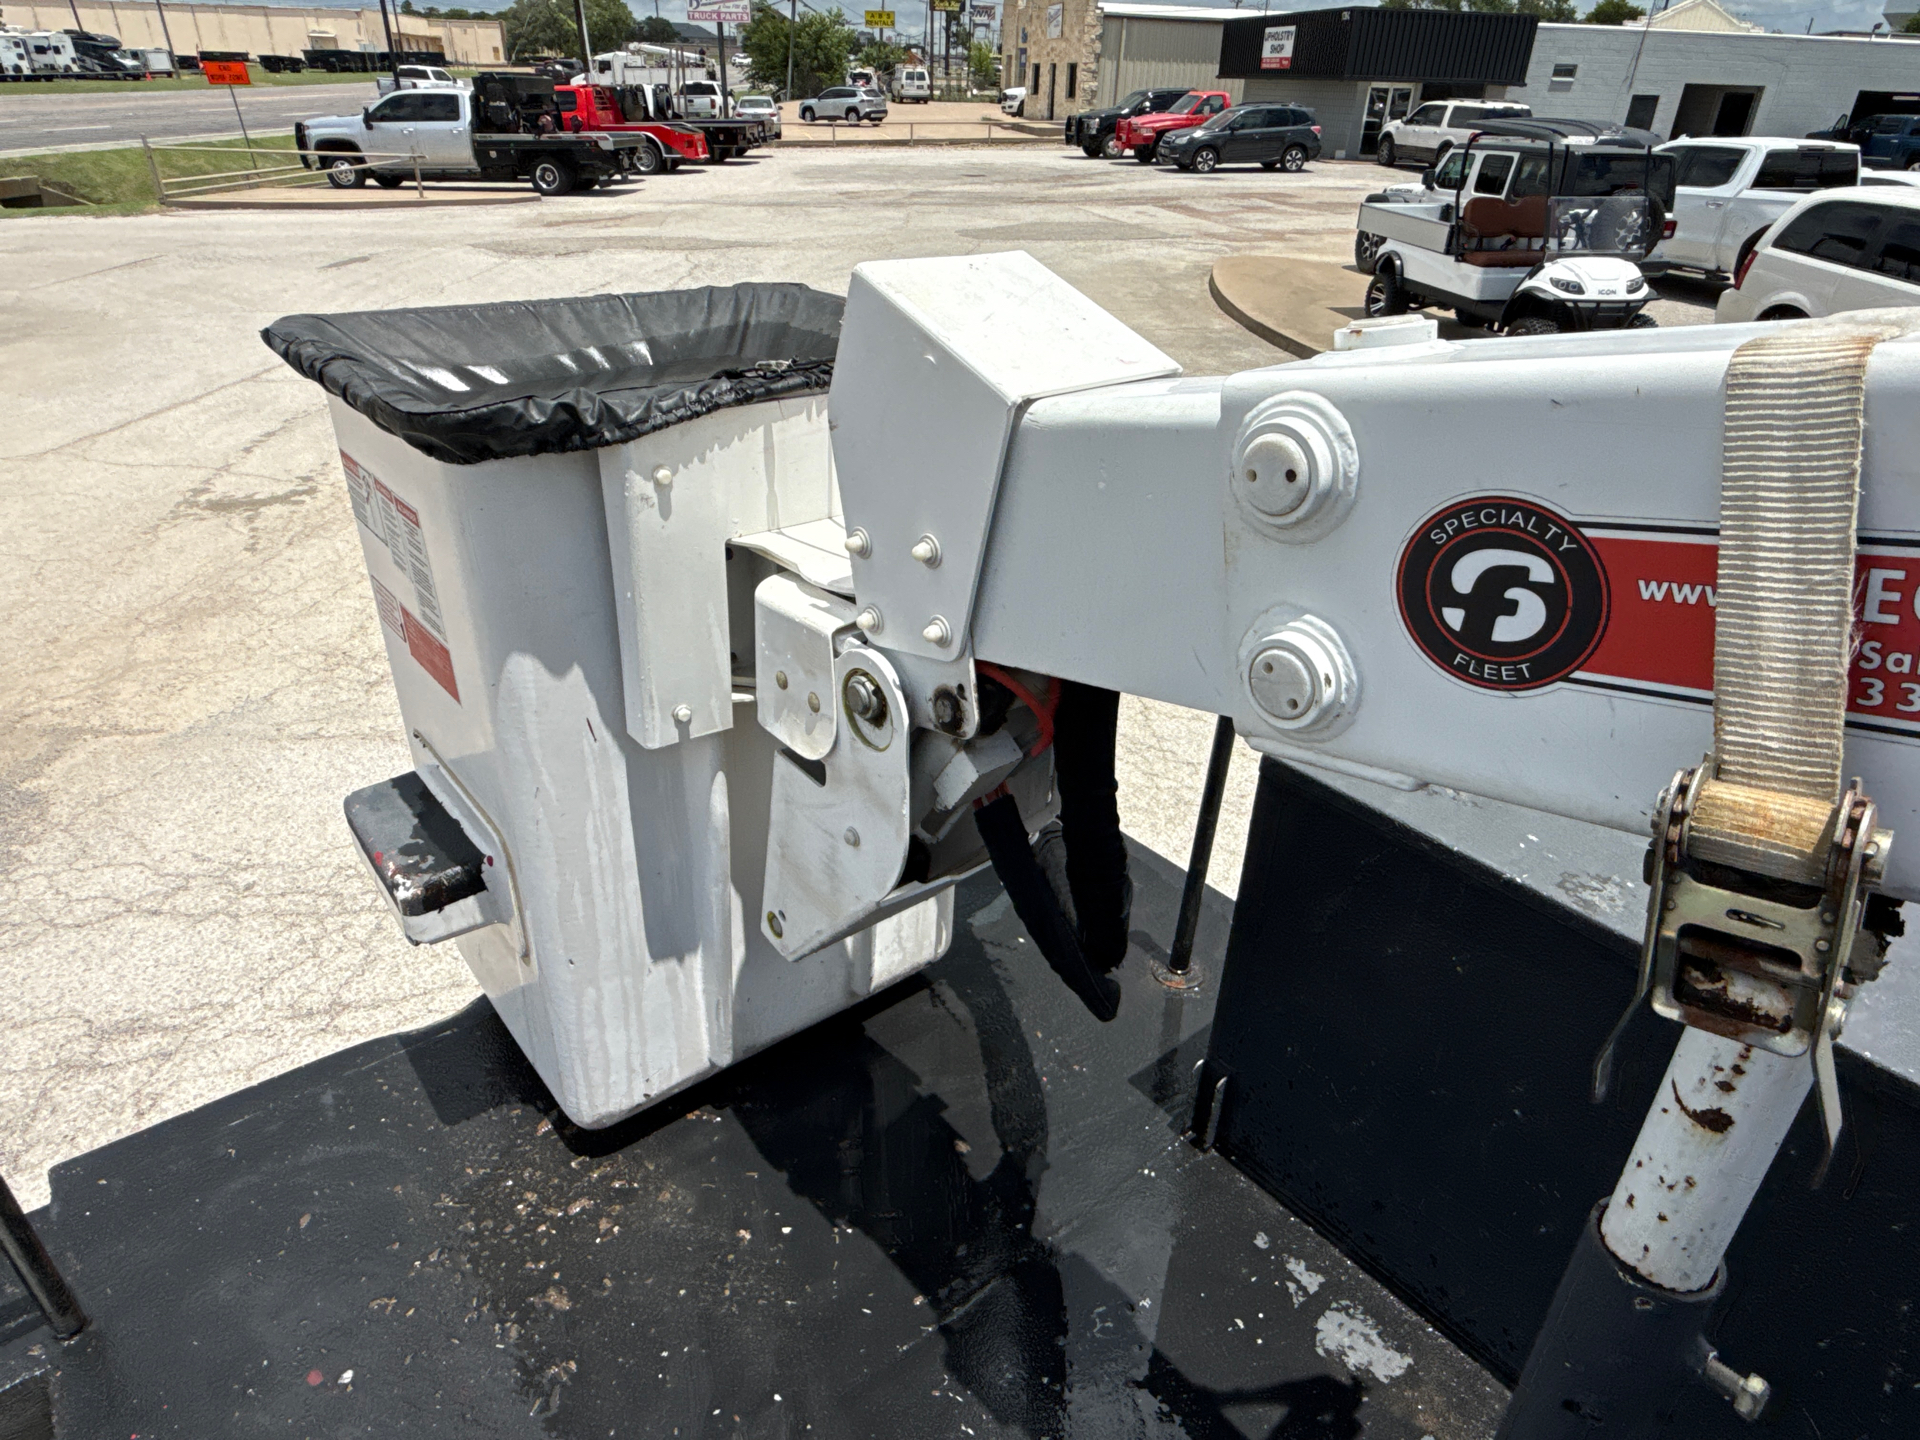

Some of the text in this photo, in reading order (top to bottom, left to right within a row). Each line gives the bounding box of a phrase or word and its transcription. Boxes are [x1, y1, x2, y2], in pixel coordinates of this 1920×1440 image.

[688, 11, 748, 20] TRUCK PARTS
[1264, 30, 1295, 42] UPHOLSTRY
[1270, 43, 1285, 54] SHOP
[1597, 288, 1617, 296] ICON
[1429, 508, 1578, 552] SPECIALTY
[1453, 652, 1531, 681] FLEET
